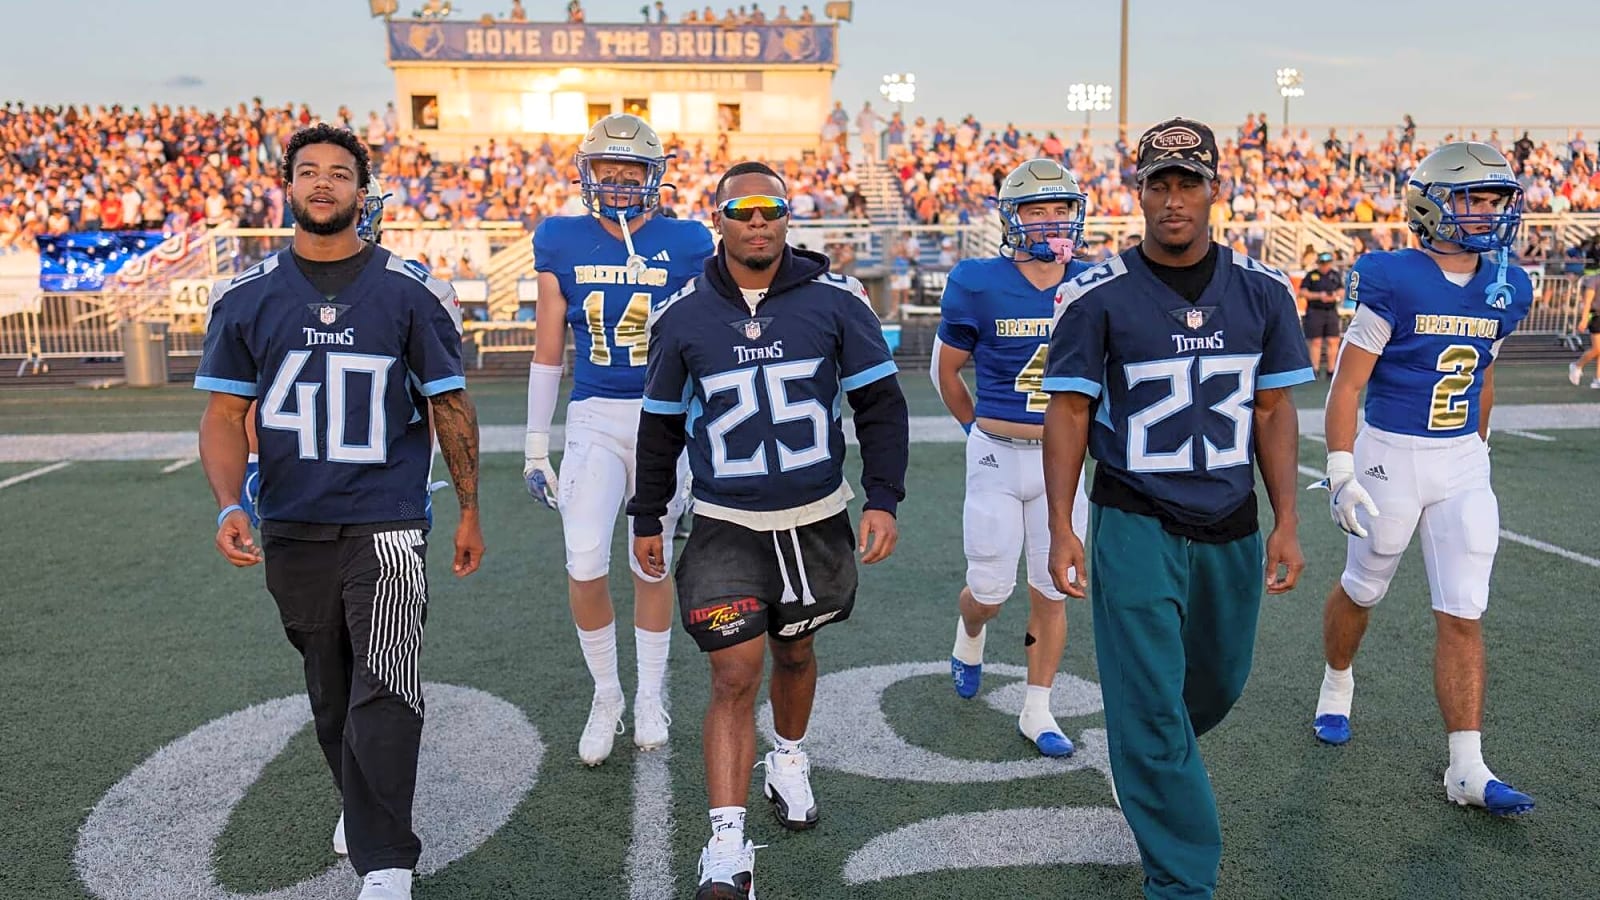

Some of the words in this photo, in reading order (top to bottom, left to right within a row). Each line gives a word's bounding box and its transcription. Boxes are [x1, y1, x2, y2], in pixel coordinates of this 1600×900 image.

[465, 29, 542, 55] HOME
[551, 30, 585, 55] OF
[596, 31, 649, 56] THE
[660, 31, 760, 57] BRUINS
[176, 285, 209, 307] 40
[1349, 271, 1360, 300] 2
[582, 291, 652, 368] 14
[995, 318, 1057, 337] BRENT
[1414, 315, 1499, 339] BRENTWOO
[260, 350, 397, 464] 40
[1015, 344, 1052, 413] 4
[1123, 353, 1263, 472] 23
[1428, 344, 1480, 430] 2
[700, 357, 832, 479] 25
